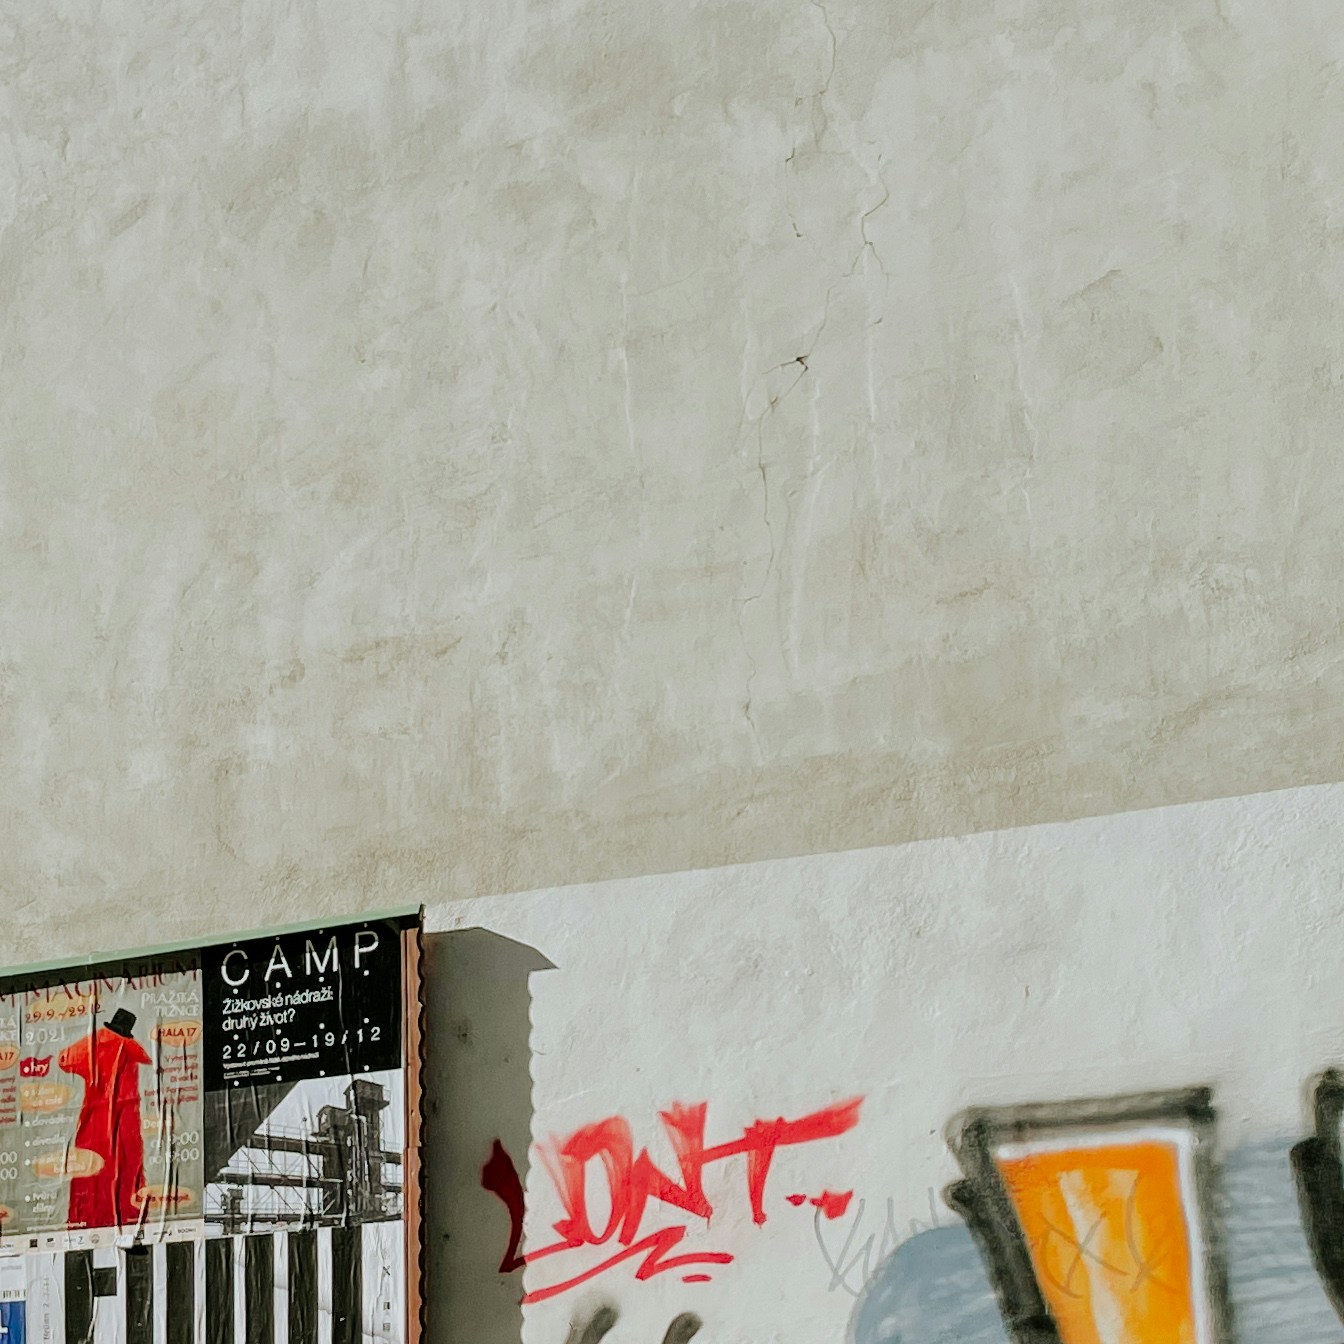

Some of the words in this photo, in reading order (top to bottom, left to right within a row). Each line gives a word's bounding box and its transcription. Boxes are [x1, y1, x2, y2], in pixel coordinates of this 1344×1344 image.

[221, 931, 379, 986] CAMP
[222, 1013, 257, 1031] druhý
[259, 1008, 295, 1027] život?
[186, 1028, 197, 1037] 17
[30, 1061, 49, 1074] hry
